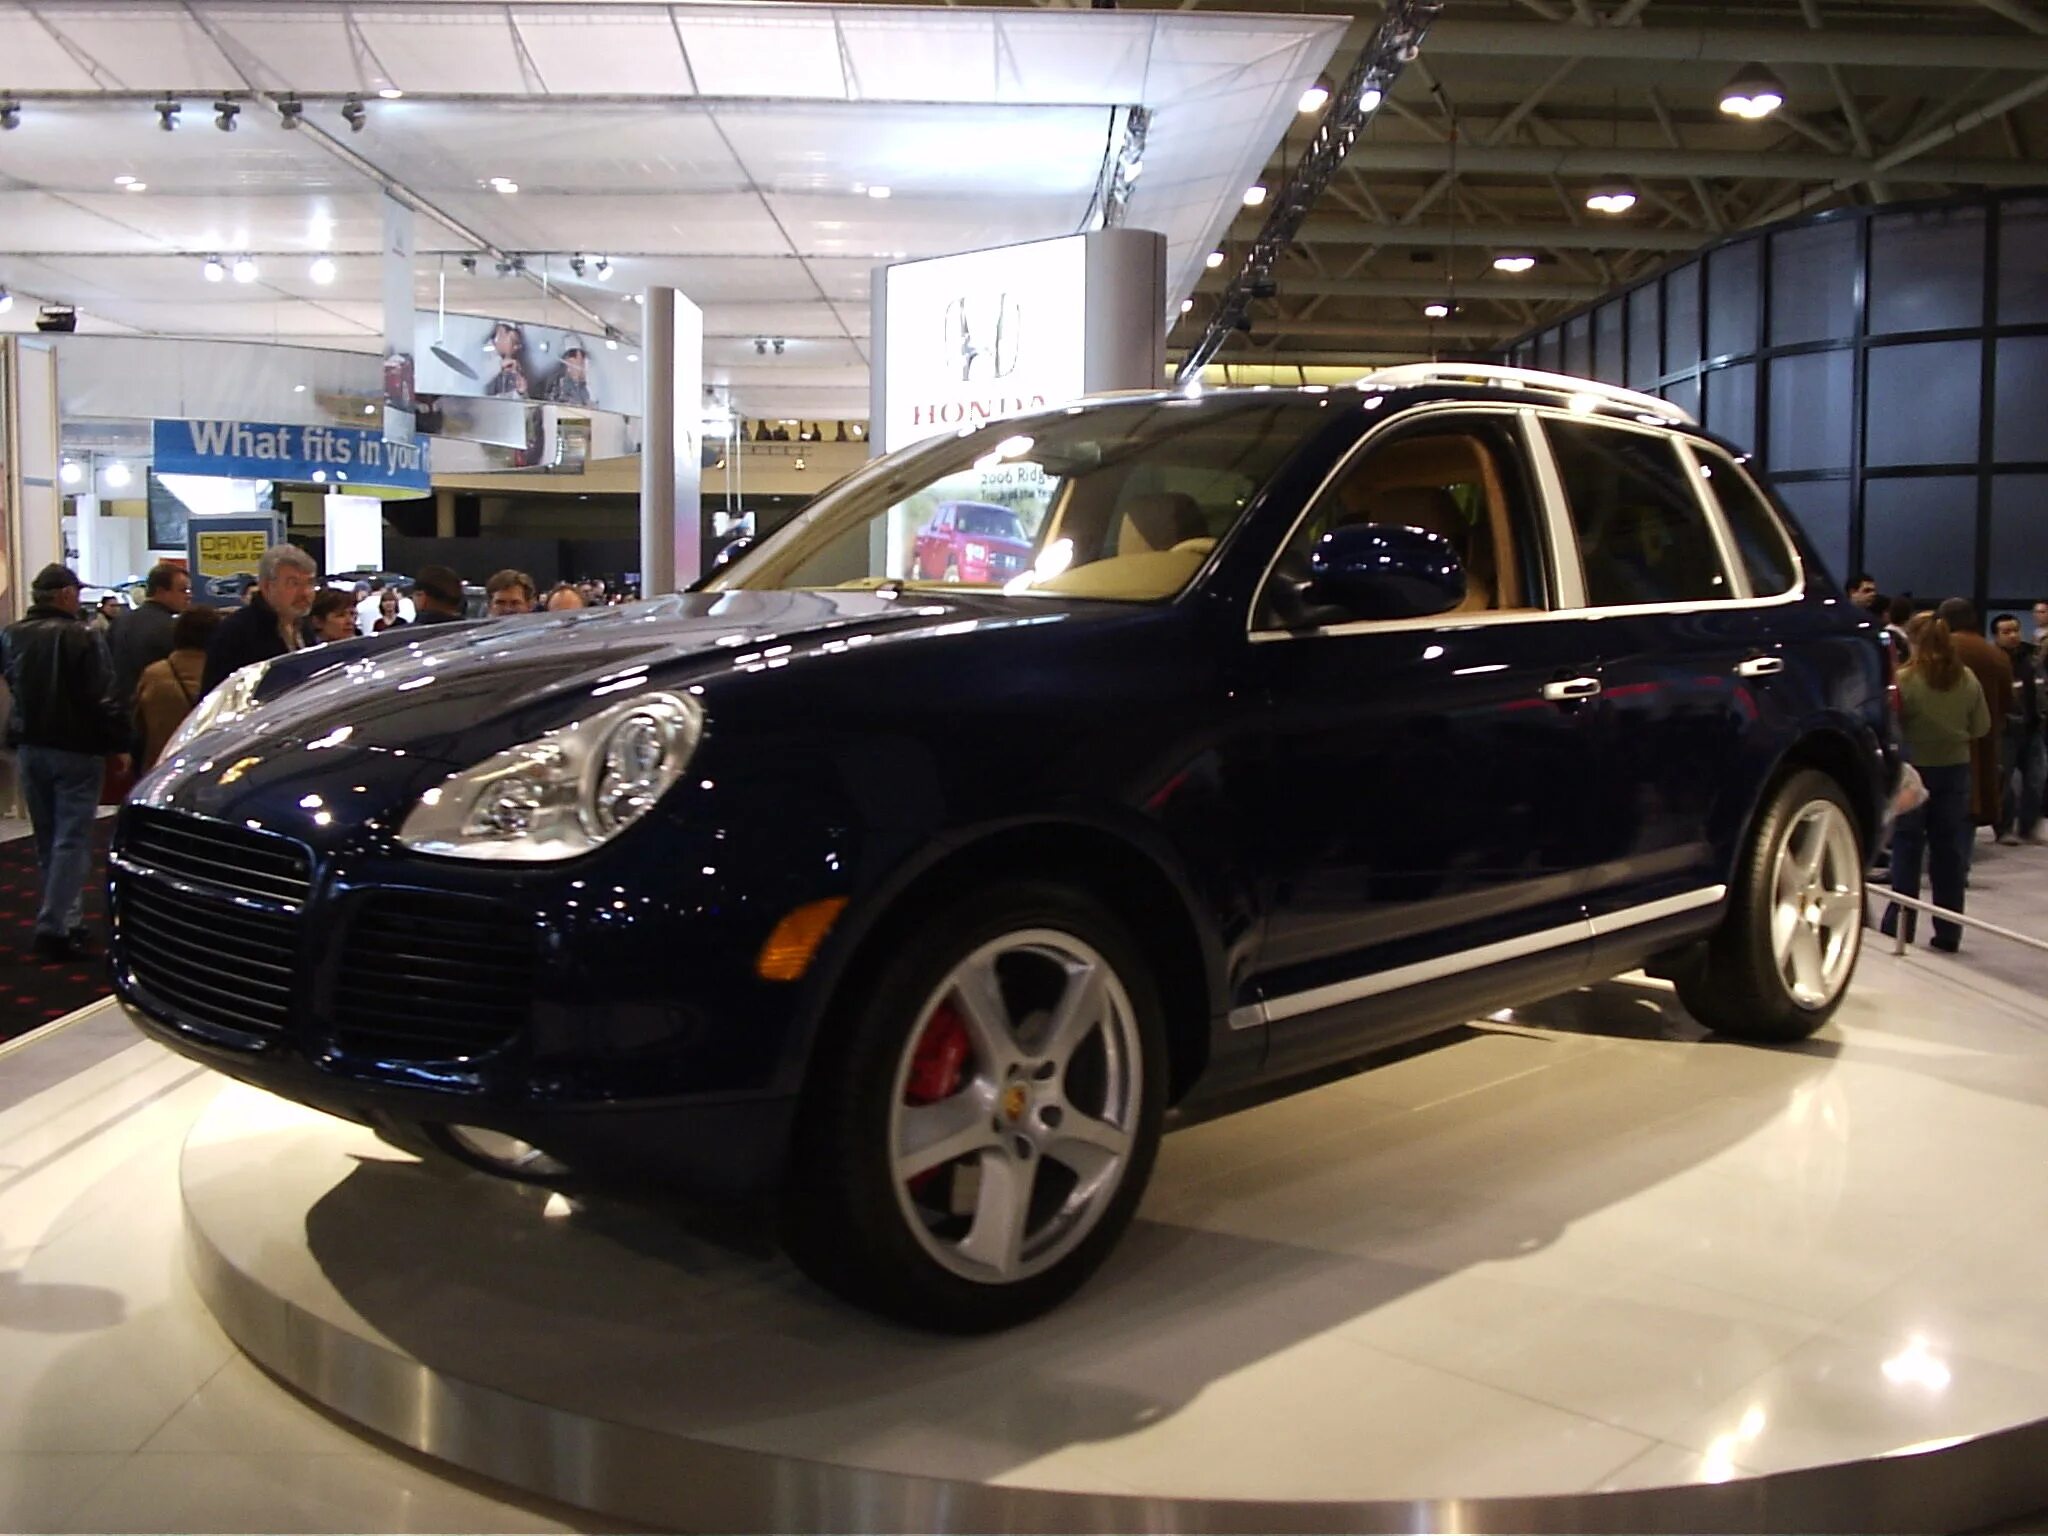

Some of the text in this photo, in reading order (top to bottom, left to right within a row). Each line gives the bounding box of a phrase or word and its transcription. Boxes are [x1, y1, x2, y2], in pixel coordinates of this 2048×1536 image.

[913, 395, 1045, 425] HONDA
[188, 420, 291, 461] What
[302, 426, 351, 464] fits
[359, 431, 381, 467] in
[385, 440, 421, 477] your
[981, 471, 1013, 485] 2006
[201, 535, 265, 552] DRIVE
[202, 552, 221, 561] THE
[225, 552, 248, 561] CAR
